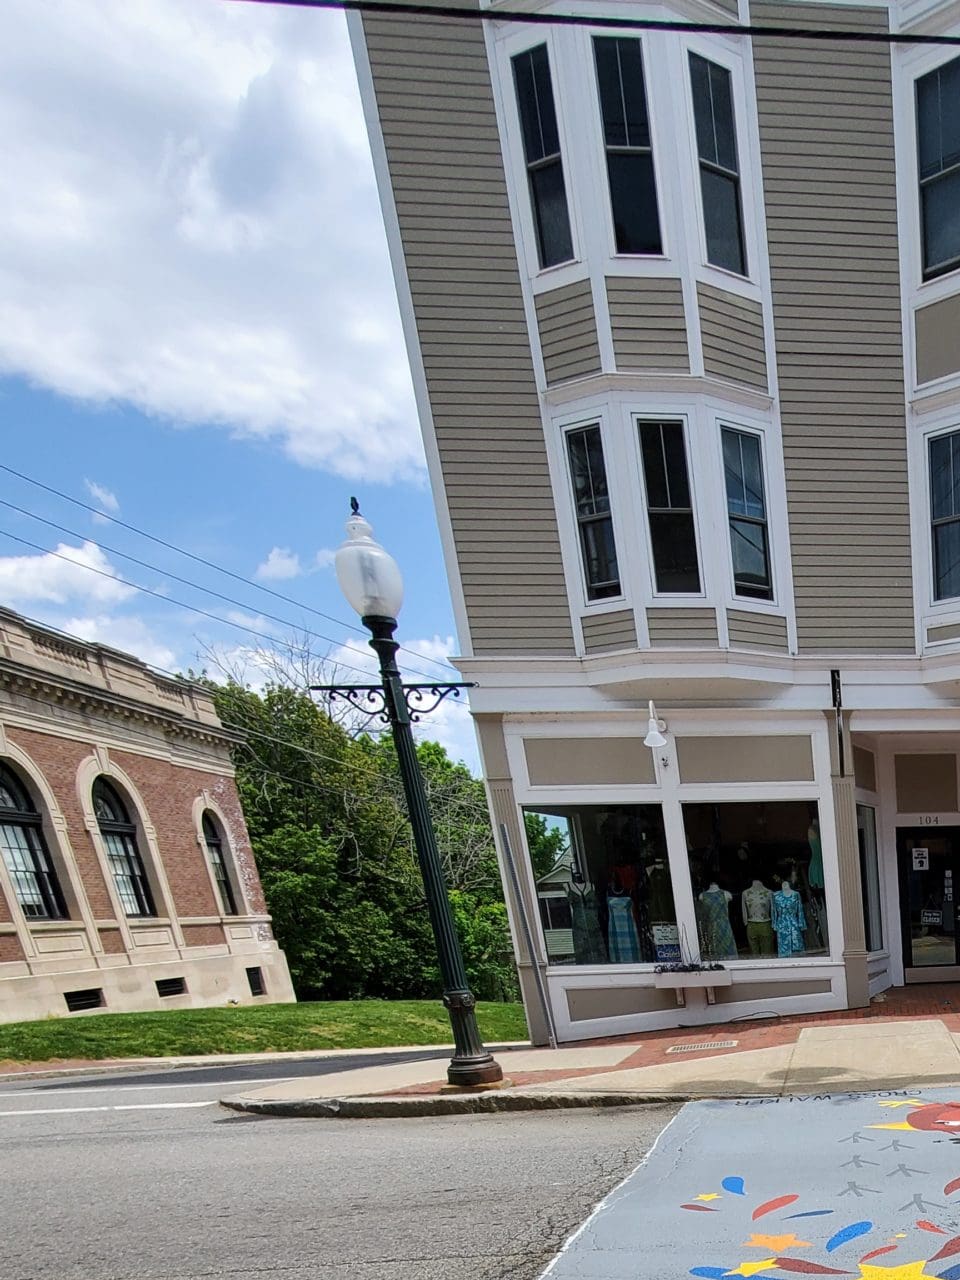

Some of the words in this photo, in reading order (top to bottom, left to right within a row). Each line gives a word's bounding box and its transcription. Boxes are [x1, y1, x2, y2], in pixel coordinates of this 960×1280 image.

[919, 816, 939, 825] 104
[735, 1093, 832, 1107] WALKER
[847, 1089, 923, 1101] CROSS
